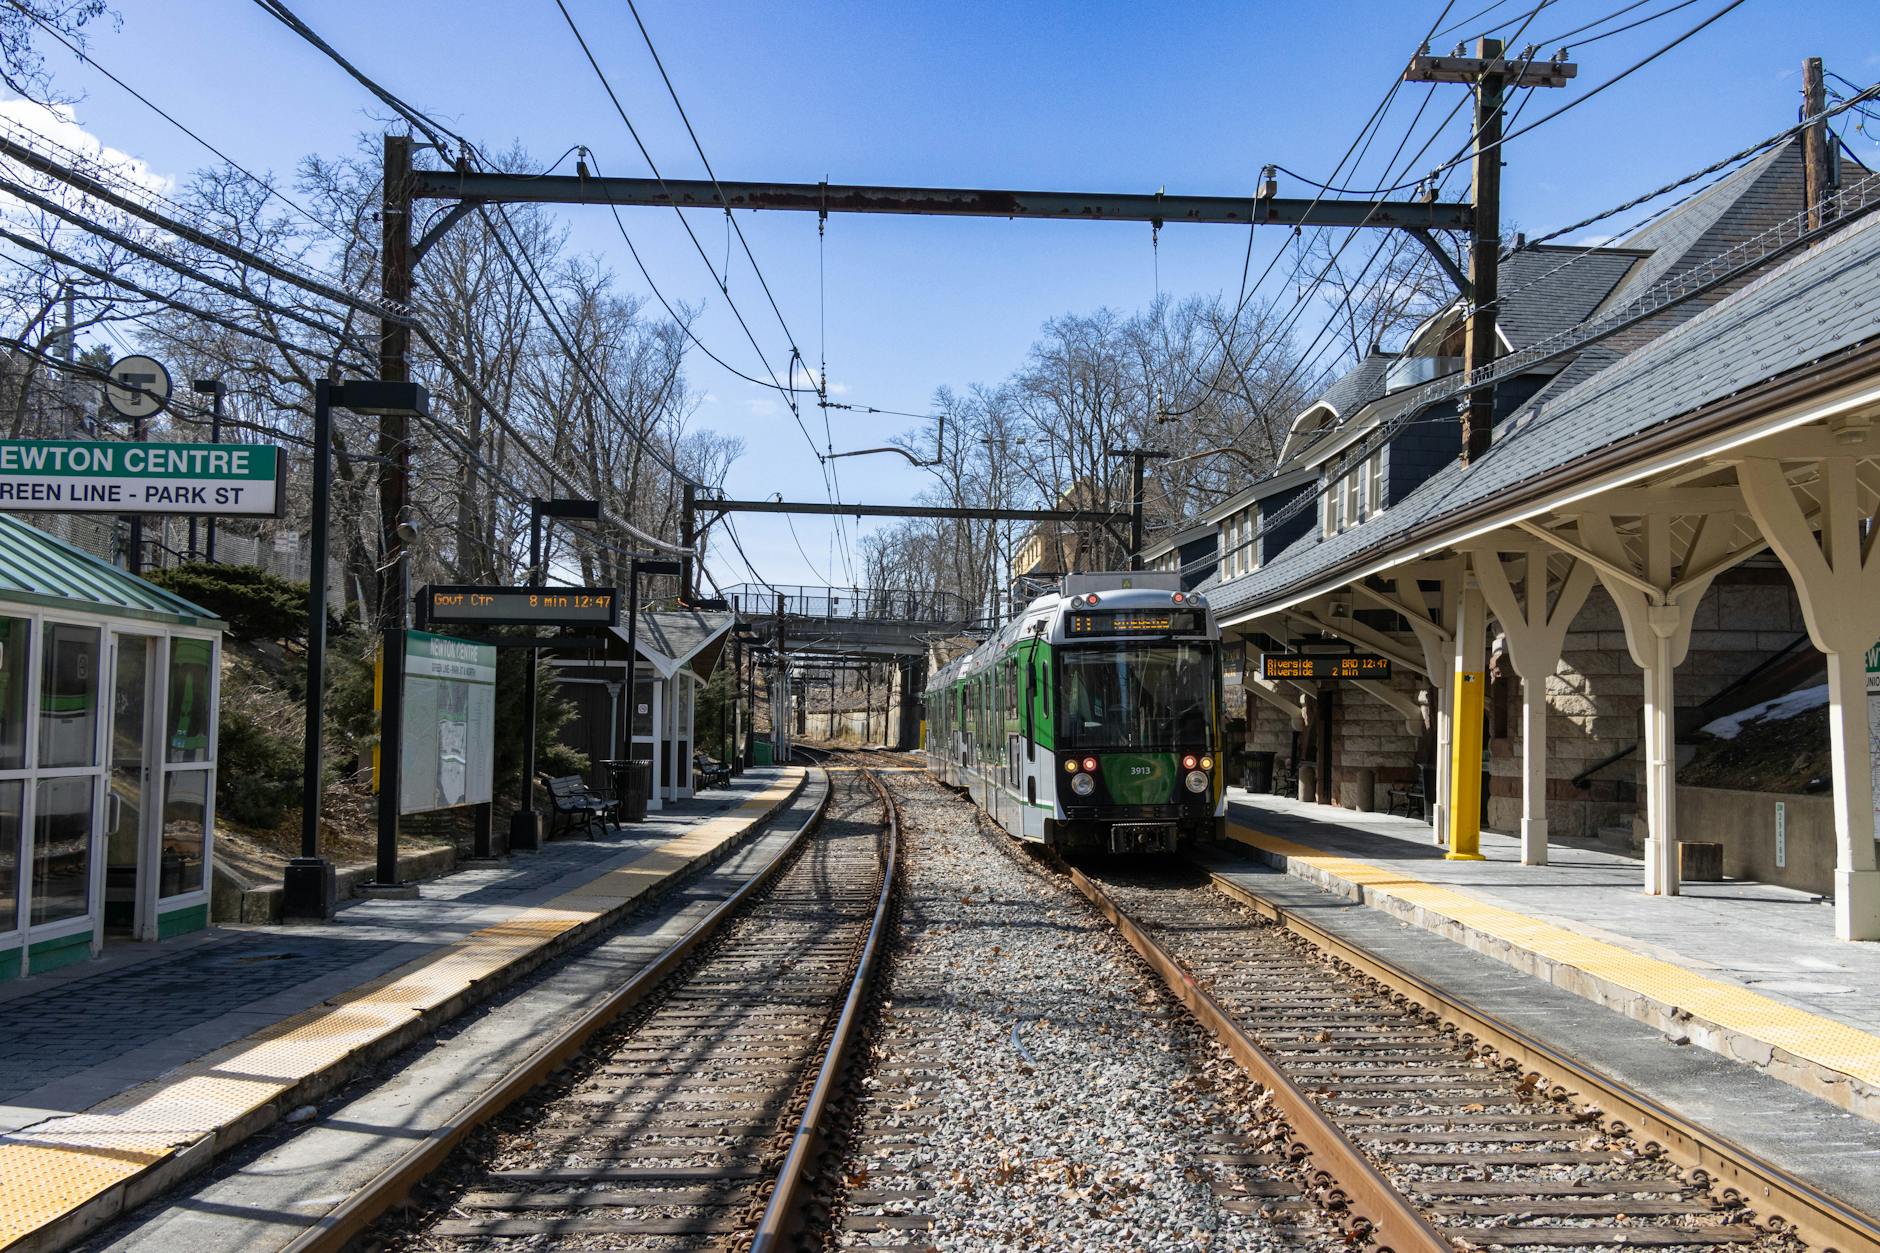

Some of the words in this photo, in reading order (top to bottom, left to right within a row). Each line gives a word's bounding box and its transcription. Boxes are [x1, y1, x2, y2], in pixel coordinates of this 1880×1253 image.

[118, 373, 156, 406] T
[124, 448, 250, 474] CENTRE
[70, 484, 121, 502] LINE
[145, 485, 207, 504] PARK
[215, 487, 244, 505] ST
[434, 593, 464, 606] Govt
[471, 593, 494, 606] Ctr
[529, 595, 538, 607] 8
[544, 596, 567, 608] min
[574, 596, 611, 608] 12:47
[1267, 659, 1313, 668] Riverside
[1342, 659, 1358, 668] BRD
[1362, 659, 1388, 668] 12:47
[1267, 667, 1313, 676] Riverside
[1332, 667, 1338, 676] 2
[1342, 668, 1358, 676] min
[1130, 766, 1151, 775] 3913
